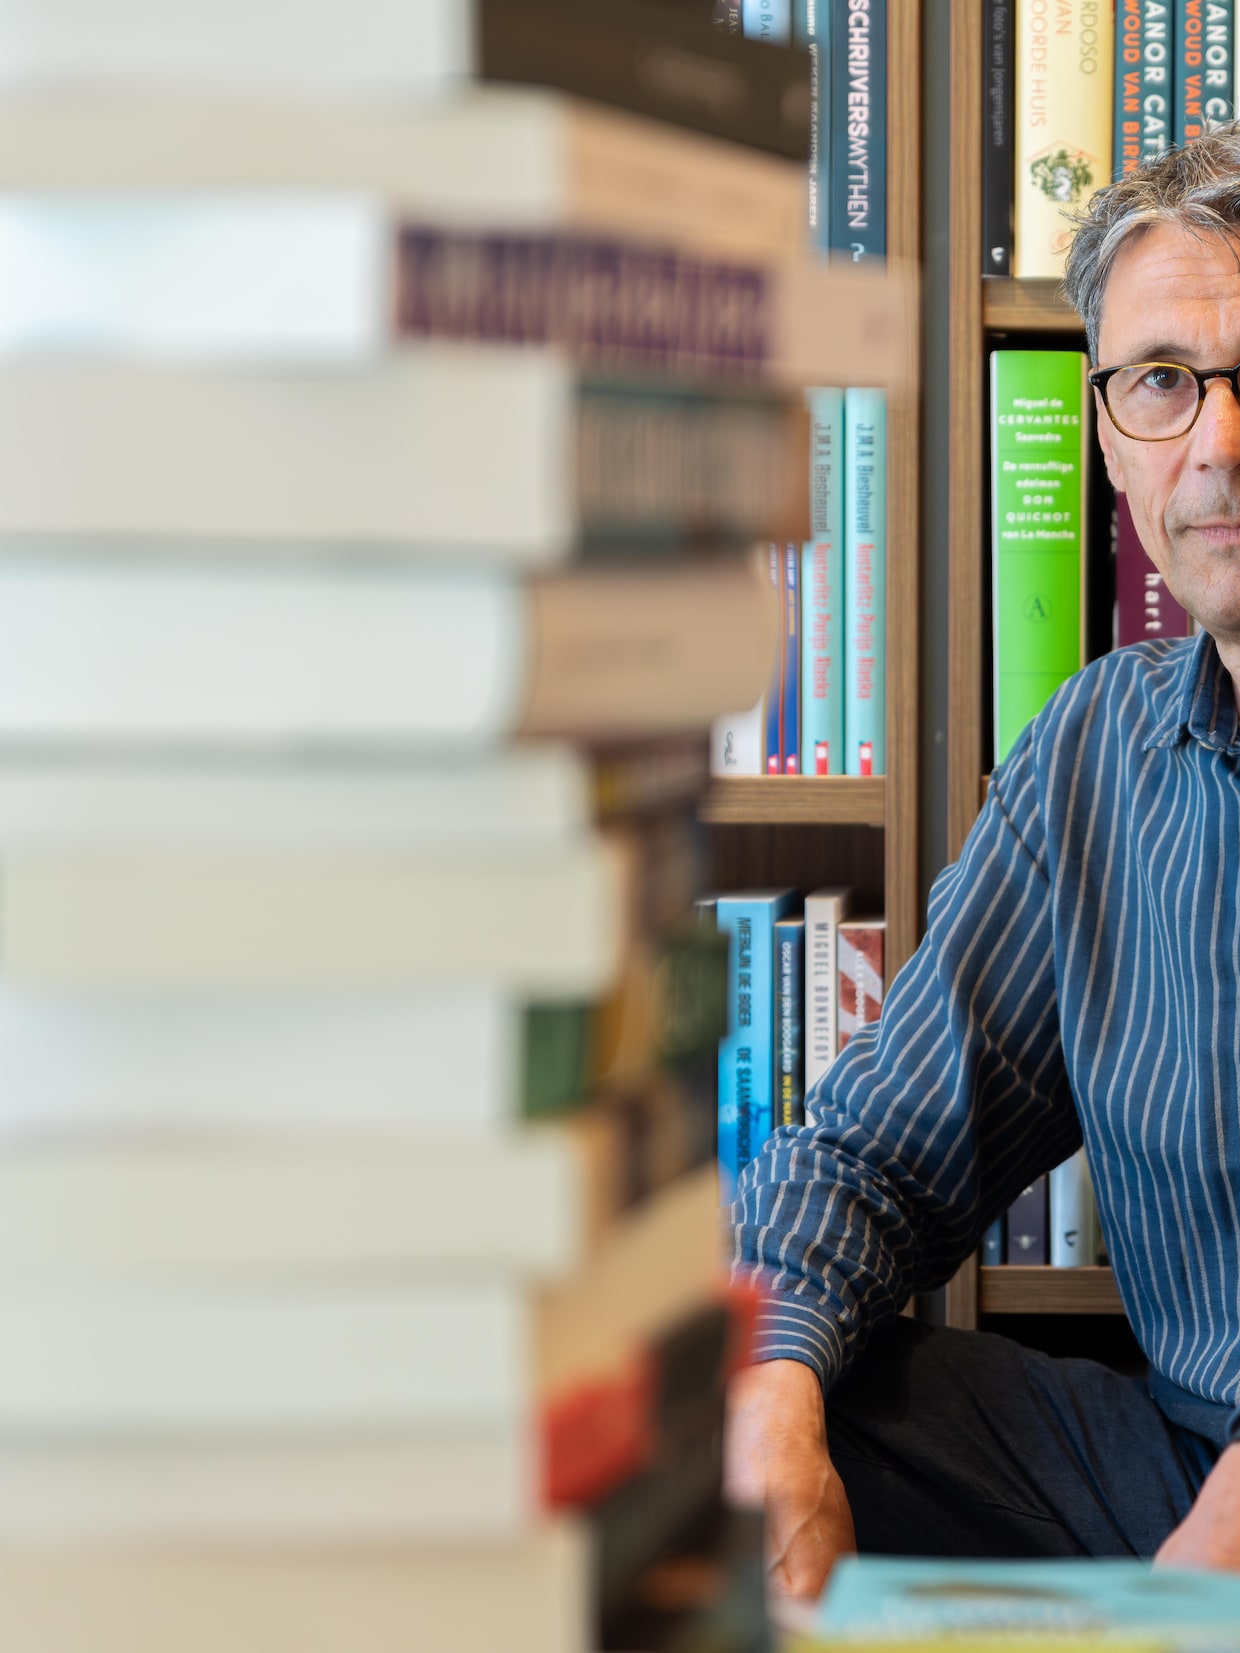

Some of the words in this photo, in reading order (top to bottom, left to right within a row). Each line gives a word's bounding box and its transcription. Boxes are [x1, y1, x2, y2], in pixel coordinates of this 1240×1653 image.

[1079, 1, 1098, 76] RDOSO
[1123, 0, 1140, 64] WOUD
[1184, 0, 1202, 67] WOUD
[1029, 79, 1049, 128] HUIS
[1123, 71, 1140, 113] VAN
[1184, 74, 1202, 116] VAN
[1143, 94, 1167, 162] CAT
[1122, 121, 1140, 178] BIRN
[808, 177, 818, 227] JAREN
[997, 414, 1080, 425] CERVANTES
[1012, 397, 1048, 411] Miguel
[1049, 398, 1064, 408] de
[1002, 460, 1017, 472] De
[1018, 460, 1075, 475] vernuftige
[1015, 477, 1061, 489] edelman
[813, 464, 832, 534] Biesheuvel
[855, 464, 875, 534] Biesheuvel
[1005, 511, 1071, 524] QUICHOT
[1022, 494, 1055, 506] DON
[1001, 531, 1020, 540] van
[1020, 529, 1034, 540] La
[1035, 529, 1076, 540] Mancha
[1144, 572, 1163, 632] hart
[781, 941, 793, 974] OSCAR
[813, 921, 830, 977] MIGUEL
[737, 972, 753, 990] DE
[781, 975, 793, 996] VAN
[737, 992, 753, 1028] BOER
[781, 996, 793, 1017] DEN
[813, 985, 830, 1062] BONNEFOY
[735, 1046, 753, 1064] DE
[781, 1087, 793, 1100] DE
